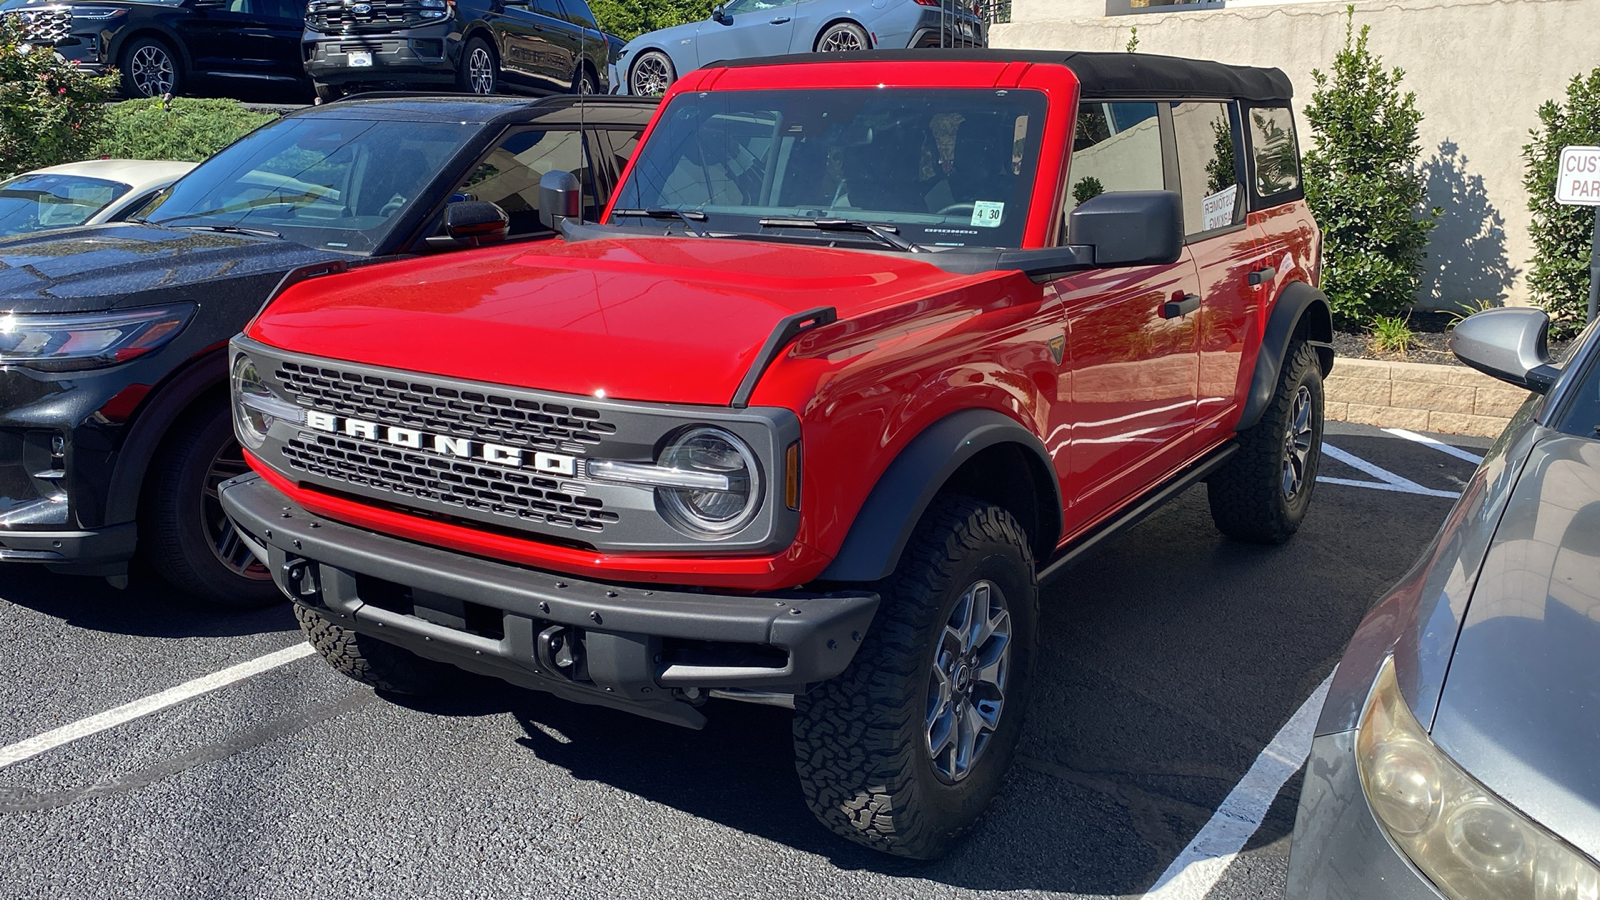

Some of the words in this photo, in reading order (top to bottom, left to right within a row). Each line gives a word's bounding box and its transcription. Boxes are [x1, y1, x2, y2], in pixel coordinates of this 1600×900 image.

[1566, 155, 1600, 173] CUS
[977, 209, 983, 219] 4
[989, 209, 1000, 220] 30
[307, 409, 577, 476] BRONCO
